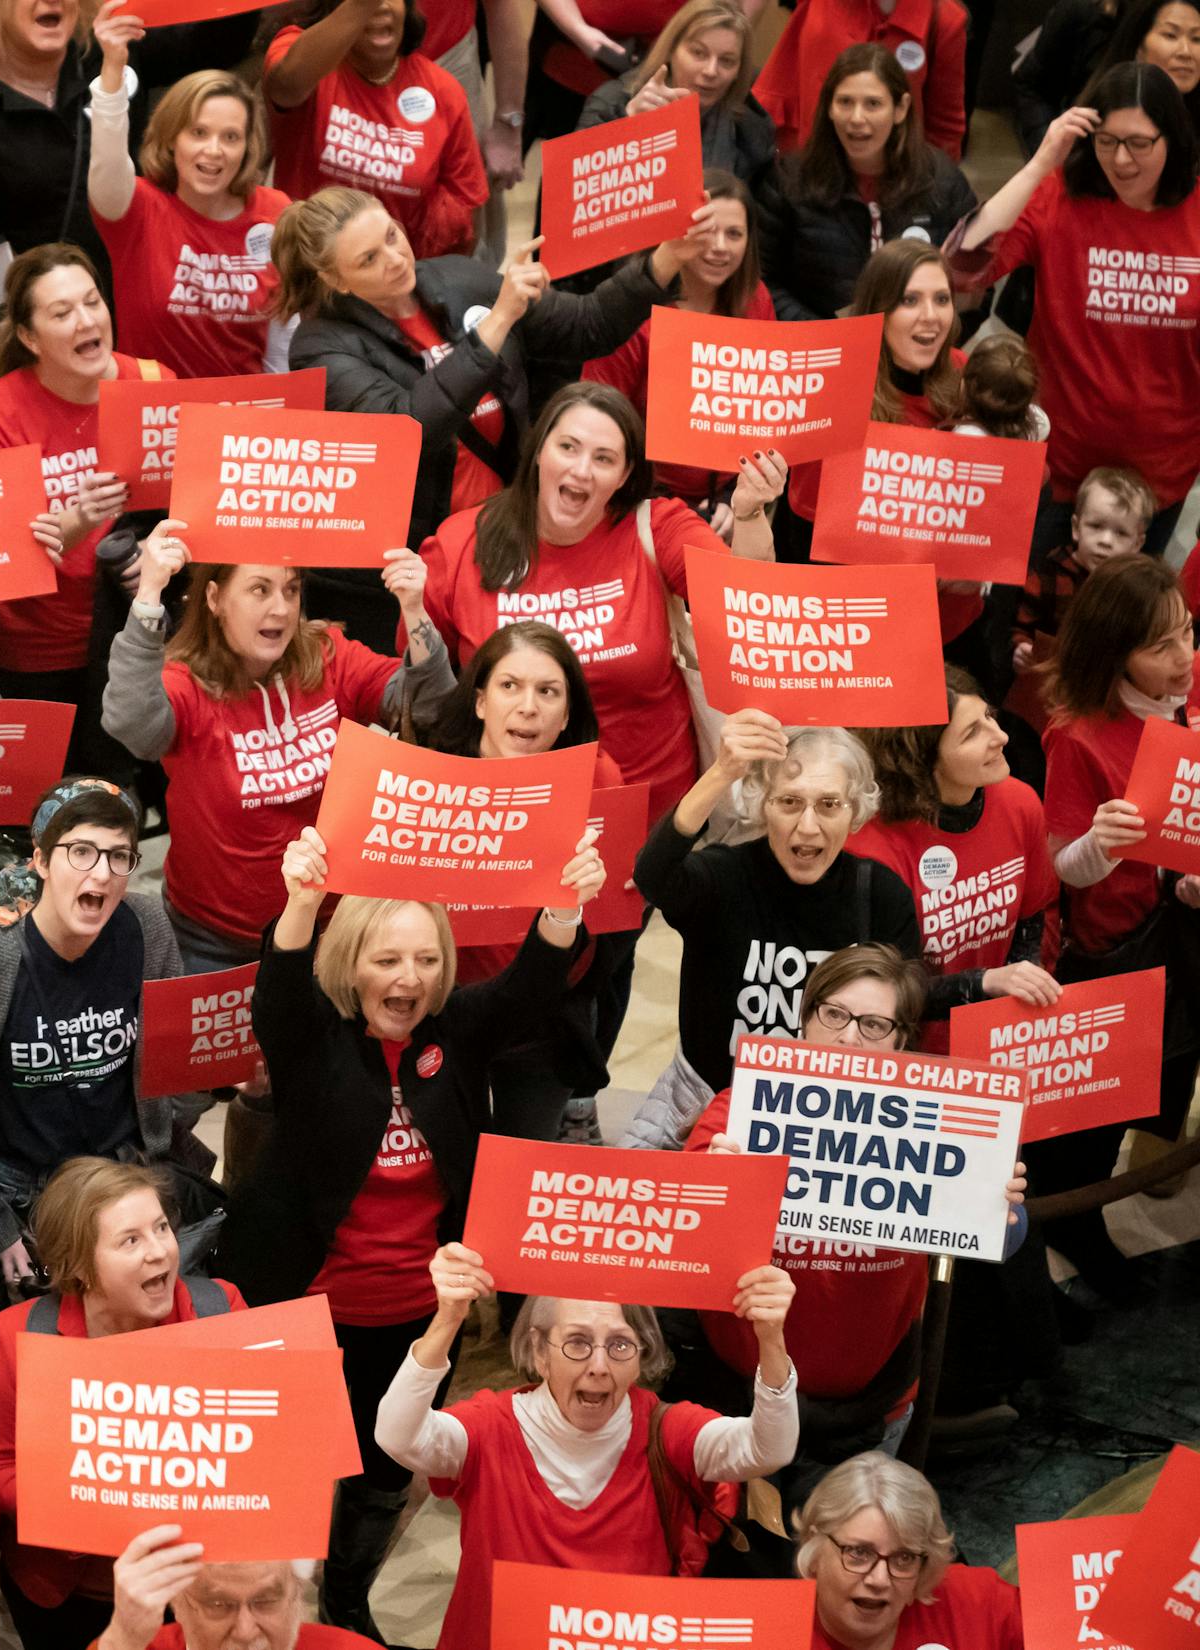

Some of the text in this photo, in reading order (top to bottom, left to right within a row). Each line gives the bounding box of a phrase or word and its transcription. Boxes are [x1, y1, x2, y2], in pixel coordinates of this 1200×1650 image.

[330, 104, 390, 140] MOMS
[321, 143, 403, 181] ACTION
[325, 124, 416, 165] DEMAND
[572, 140, 640, 178] MOMS
[573, 156, 667, 201] DEMAND
[572, 181, 654, 225] ACTION
[1088, 246, 1160, 272] MOMS
[1088, 267, 1189, 295] DEMAND
[1086, 288, 1176, 315] ACTION
[691, 341, 789, 372] MOMS
[691, 363, 825, 397] DEMAND
[689, 392, 807, 422] ACTION
[221, 434, 321, 463] MOMS
[864, 447, 955, 480] MOMS
[219, 461, 357, 489] DEMAND
[861, 471, 986, 507] DEMAND
[216, 487, 337, 514] ACTION
[857, 495, 967, 529] ACTION
[497, 588, 579, 613] MOMS
[723, 586, 825, 620] MOMS
[726, 614, 871, 646] DEMAND
[729, 643, 854, 673] ACTION
[730, 670, 894, 689] FOR GUN SENSE IN AMERICA
[236, 727, 337, 772] DEMAND
[241, 752, 332, 795] ACTION
[376, 769, 491, 807] MOMS
[370, 796, 529, 832] DEMAND
[364, 823, 504, 856] ACTION
[361, 848, 533, 871] FOR GUN SENSE IN AMERICA
[921, 871, 990, 914] MOMS
[923, 883, 1017, 935] DEMAND
[923, 909, 1007, 954] ACTION
[990, 1013, 1077, 1049] MOMS
[990, 1031, 1110, 1068] DEMAND
[43, 1072, 64, 1082] STAT
[739, 1042, 1021, 1098] NORTHFIELD CHAPTER
[752, 1078, 909, 1129] MOMS
[747, 1120, 966, 1177] DEMAND
[531, 1170, 656, 1202] MOMS
[783, 1167, 932, 1217] CTION
[527, 1195, 701, 1231] DEMAND
[778, 1210, 979, 1250] GUN SENSE IN AMERICA
[521, 1221, 674, 1255] ACTION
[519, 1247, 710, 1274] FOR GUN SENSE IN AMERICA
[70, 1378, 201, 1417] MOMS
[71, 1413, 253, 1453] DEMAND
[70, 1448, 227, 1488] ACTION
[70, 1484, 270, 1510] FOR GUN SENSE IN AMERICA
[549, 1604, 678, 1644] MOMS
